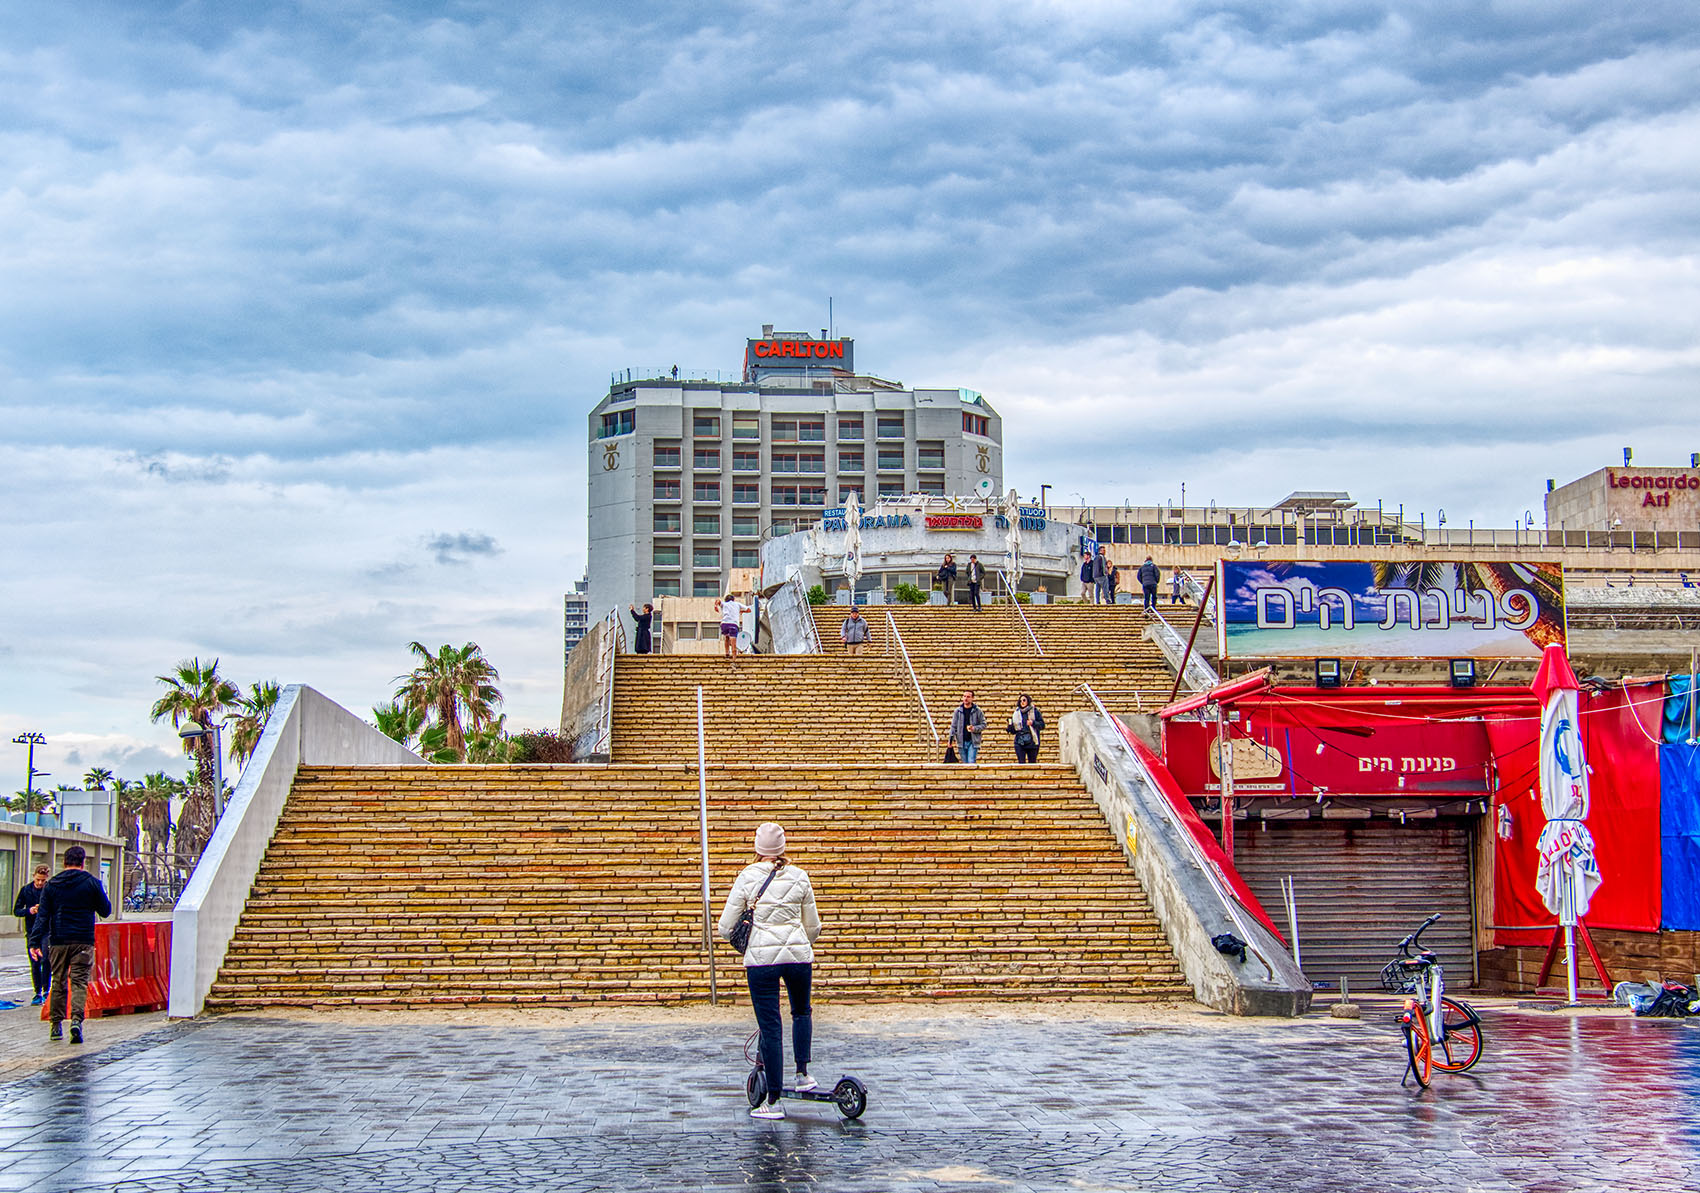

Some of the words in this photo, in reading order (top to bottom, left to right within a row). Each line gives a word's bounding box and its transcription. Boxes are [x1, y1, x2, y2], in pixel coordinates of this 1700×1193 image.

[754, 341, 844, 358] CARLTON
[1609, 472, 1700, 490] Leonardo
[1642, 491, 1671, 508] Art
[824, 507, 864, 517] RESTAU
[995, 514, 1046, 531] פנורה
[1255, 586, 1356, 631] הים
[1378, 586, 1541, 631] פנינת
[1358, 757, 1393, 772] הים
[1400, 757, 1456, 772] פנינת
